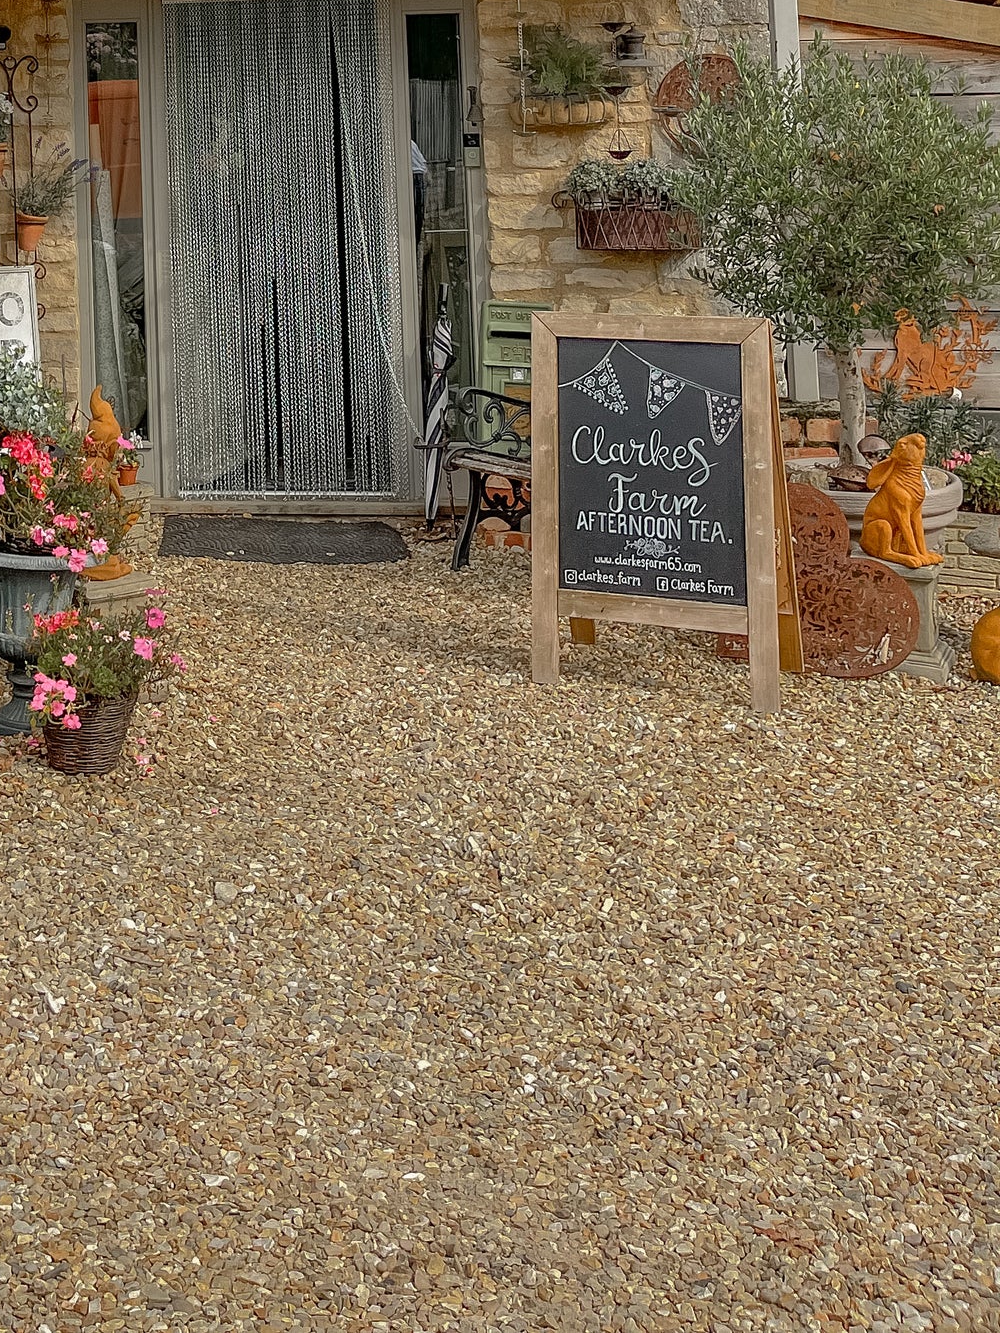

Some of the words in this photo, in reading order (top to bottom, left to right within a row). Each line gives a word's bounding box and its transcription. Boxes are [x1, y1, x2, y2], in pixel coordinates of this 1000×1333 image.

[490, 310, 512, 320] POST
[571, 425, 720, 487] Clarkes
[607, 472, 707, 517] Farm
[576, 510, 681, 540] AFTERNOON
[688, 519, 733, 544] TEA.
[594, 554, 702, 574] www.clarkesfarm65.com
[578, 571, 641, 587] clarkes_farm
[670, 578, 706, 593] Clarkes
[706, 580, 735, 596] Farm
